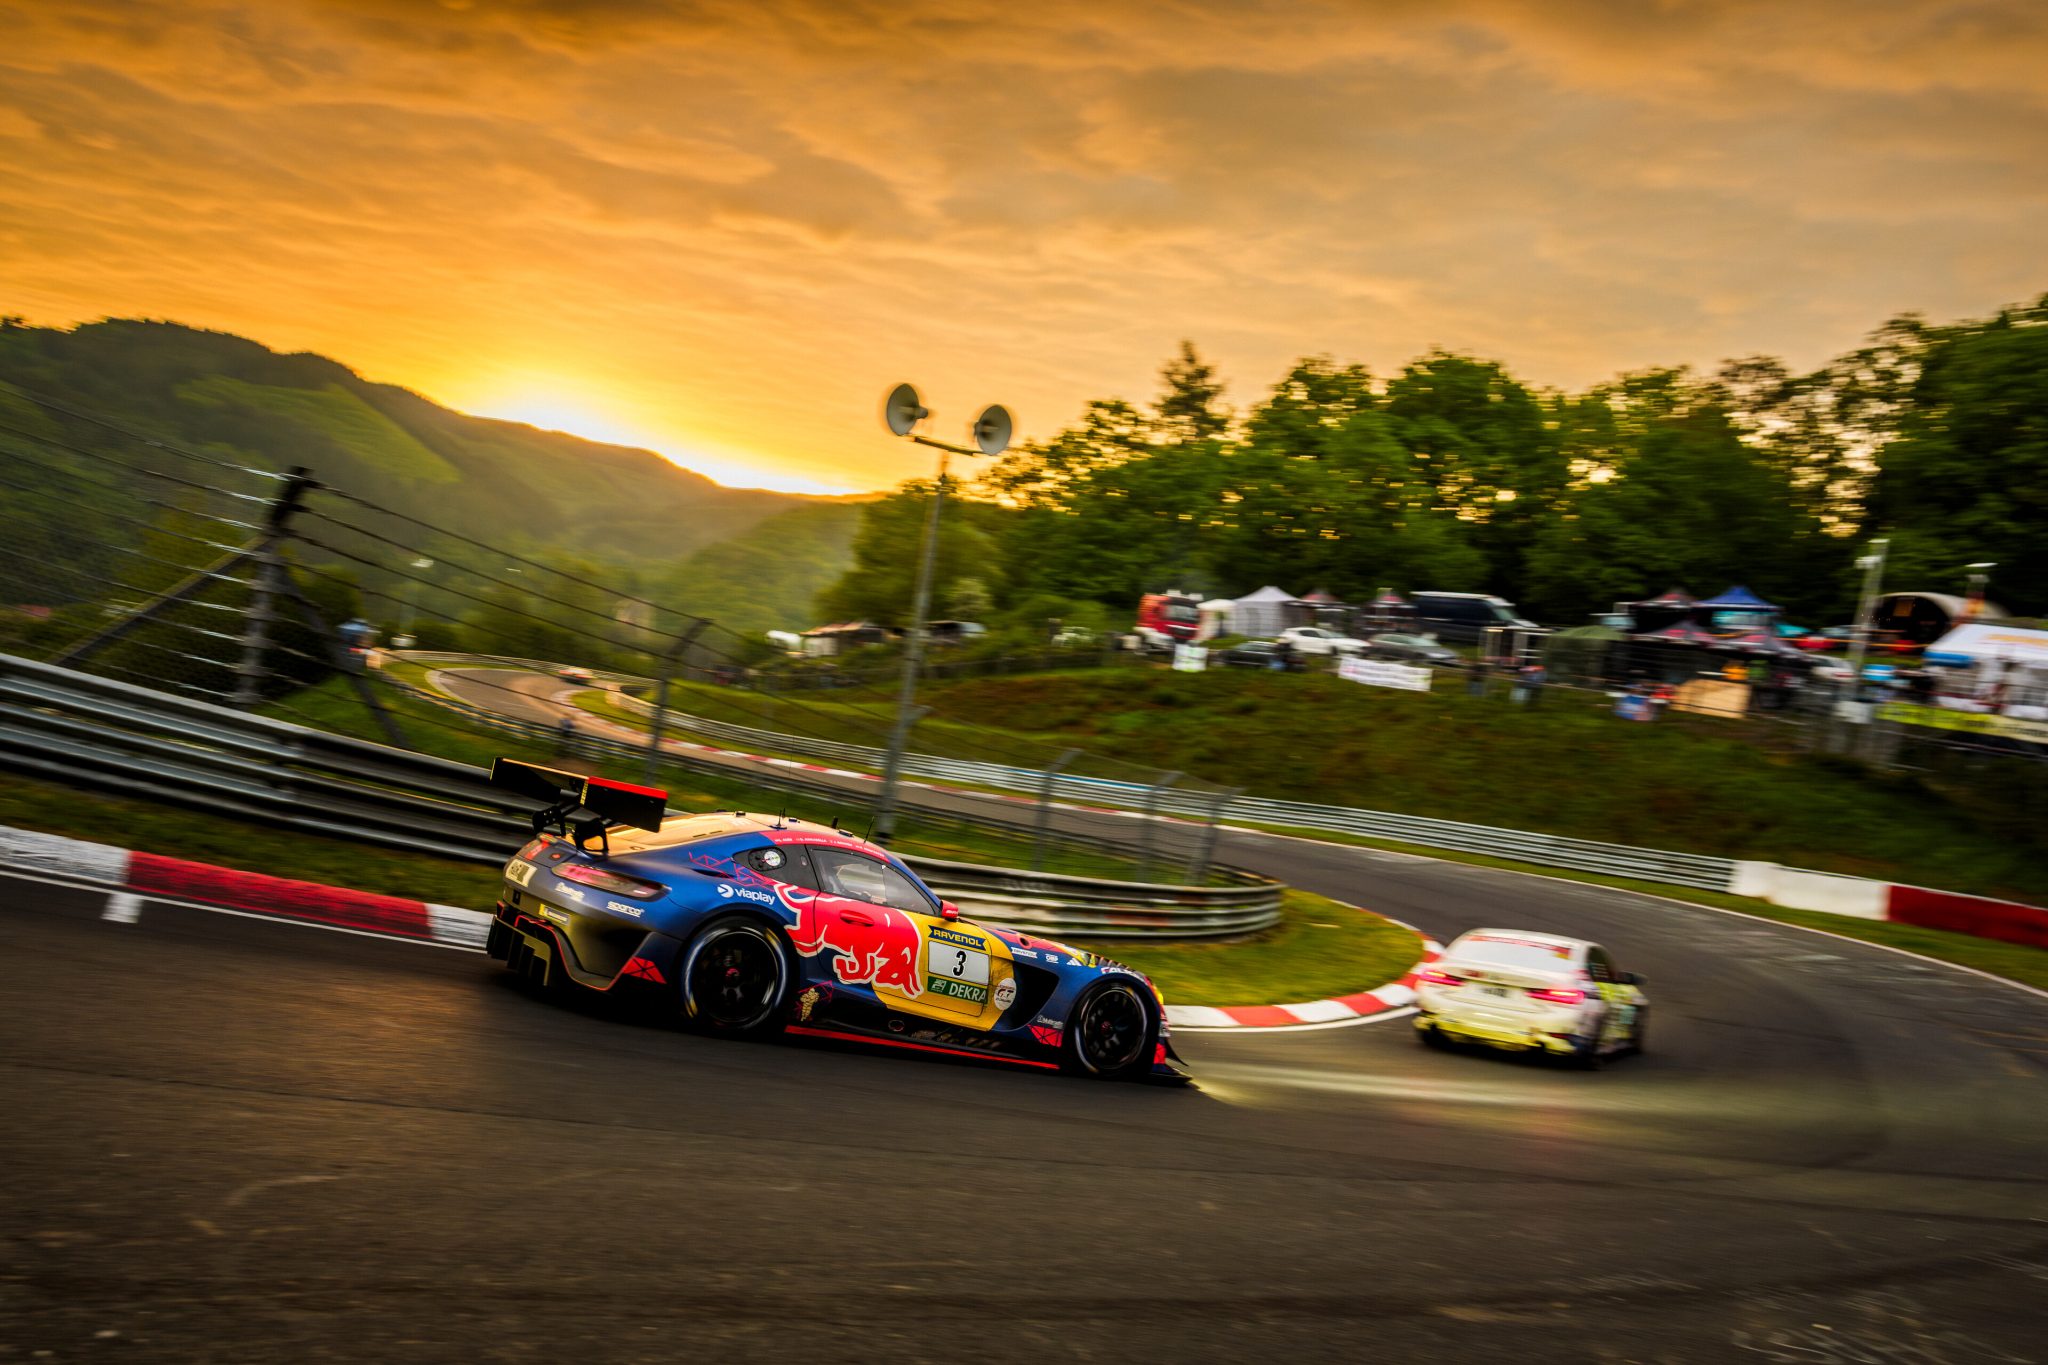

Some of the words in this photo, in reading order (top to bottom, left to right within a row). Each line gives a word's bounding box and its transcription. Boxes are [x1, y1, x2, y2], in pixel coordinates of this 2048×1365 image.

[734, 888, 776, 905] viaplay
[933, 929, 982, 947] RAVENOL
[952, 950, 967, 977] 3
[948, 982, 987, 1002] DEKRA
